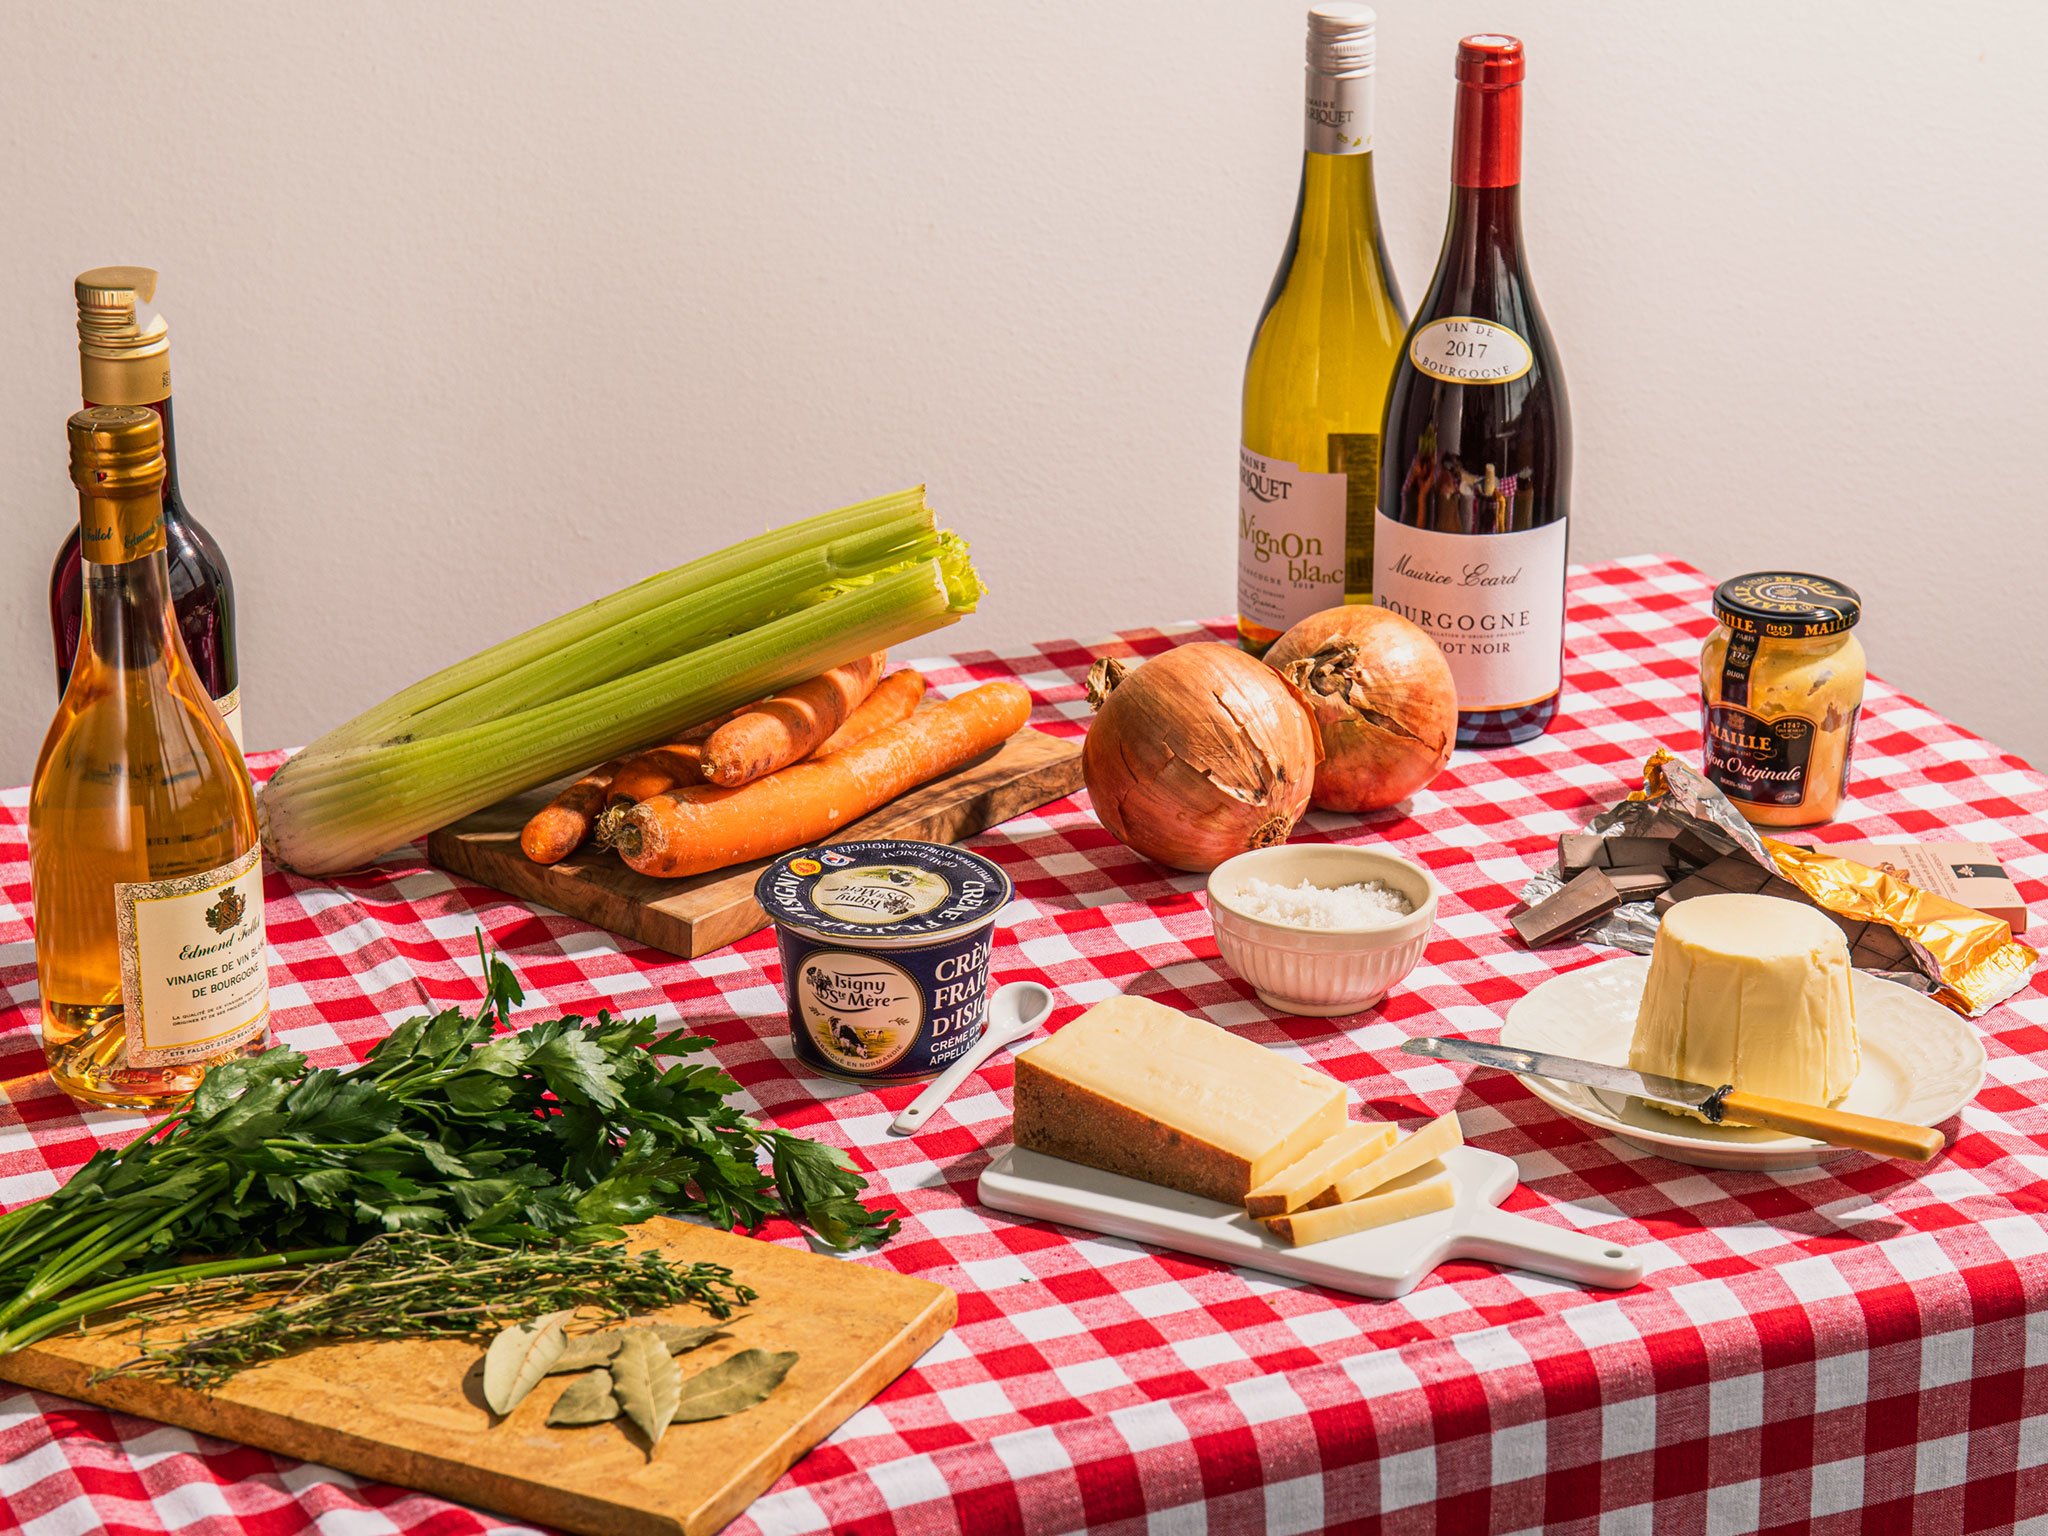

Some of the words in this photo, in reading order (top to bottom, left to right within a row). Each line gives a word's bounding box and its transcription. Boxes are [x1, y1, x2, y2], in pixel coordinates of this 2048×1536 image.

[1445, 323, 1469, 333] VIN
[1476, 326, 1495, 338] DE
[1445, 340, 1488, 359] 2017
[1422, 356, 1512, 379] BOURGOGNE
[1288, 559, 1345, 585] blanc
[1388, 553, 1453, 585] Maurice
[1457, 563, 1523, 588] Ecard
[1381, 594, 1531, 632] BOURGOGNE
[1471, 642, 1511, 655] NOIR
[1732, 650, 1751, 661] 1747
[1726, 669, 1746, 680] DIJON
[1709, 720, 1772, 751] MAILLE
[1726, 756, 1802, 783] Originale
[835, 893, 881, 909] Isigny
[179, 932, 235, 961] Edmond
[166, 967, 218, 987] VINAIGRE
[221, 960, 234, 973] DE
[236, 953, 250, 967] VIN
[192, 986, 207, 998] DE
[210, 962, 259, 994] BOURGOGNE
[835, 975, 886, 995] Isigny
[847, 994, 891, 1007] Mère
[169, 1050, 186, 1058] ETS
[187, 1043, 215, 1055] FALLOT
[930, 1030, 969, 1053] CRÈME
[846, 1060, 857, 1068] EN
[859, 1044, 904, 1068] NORMANDIE
